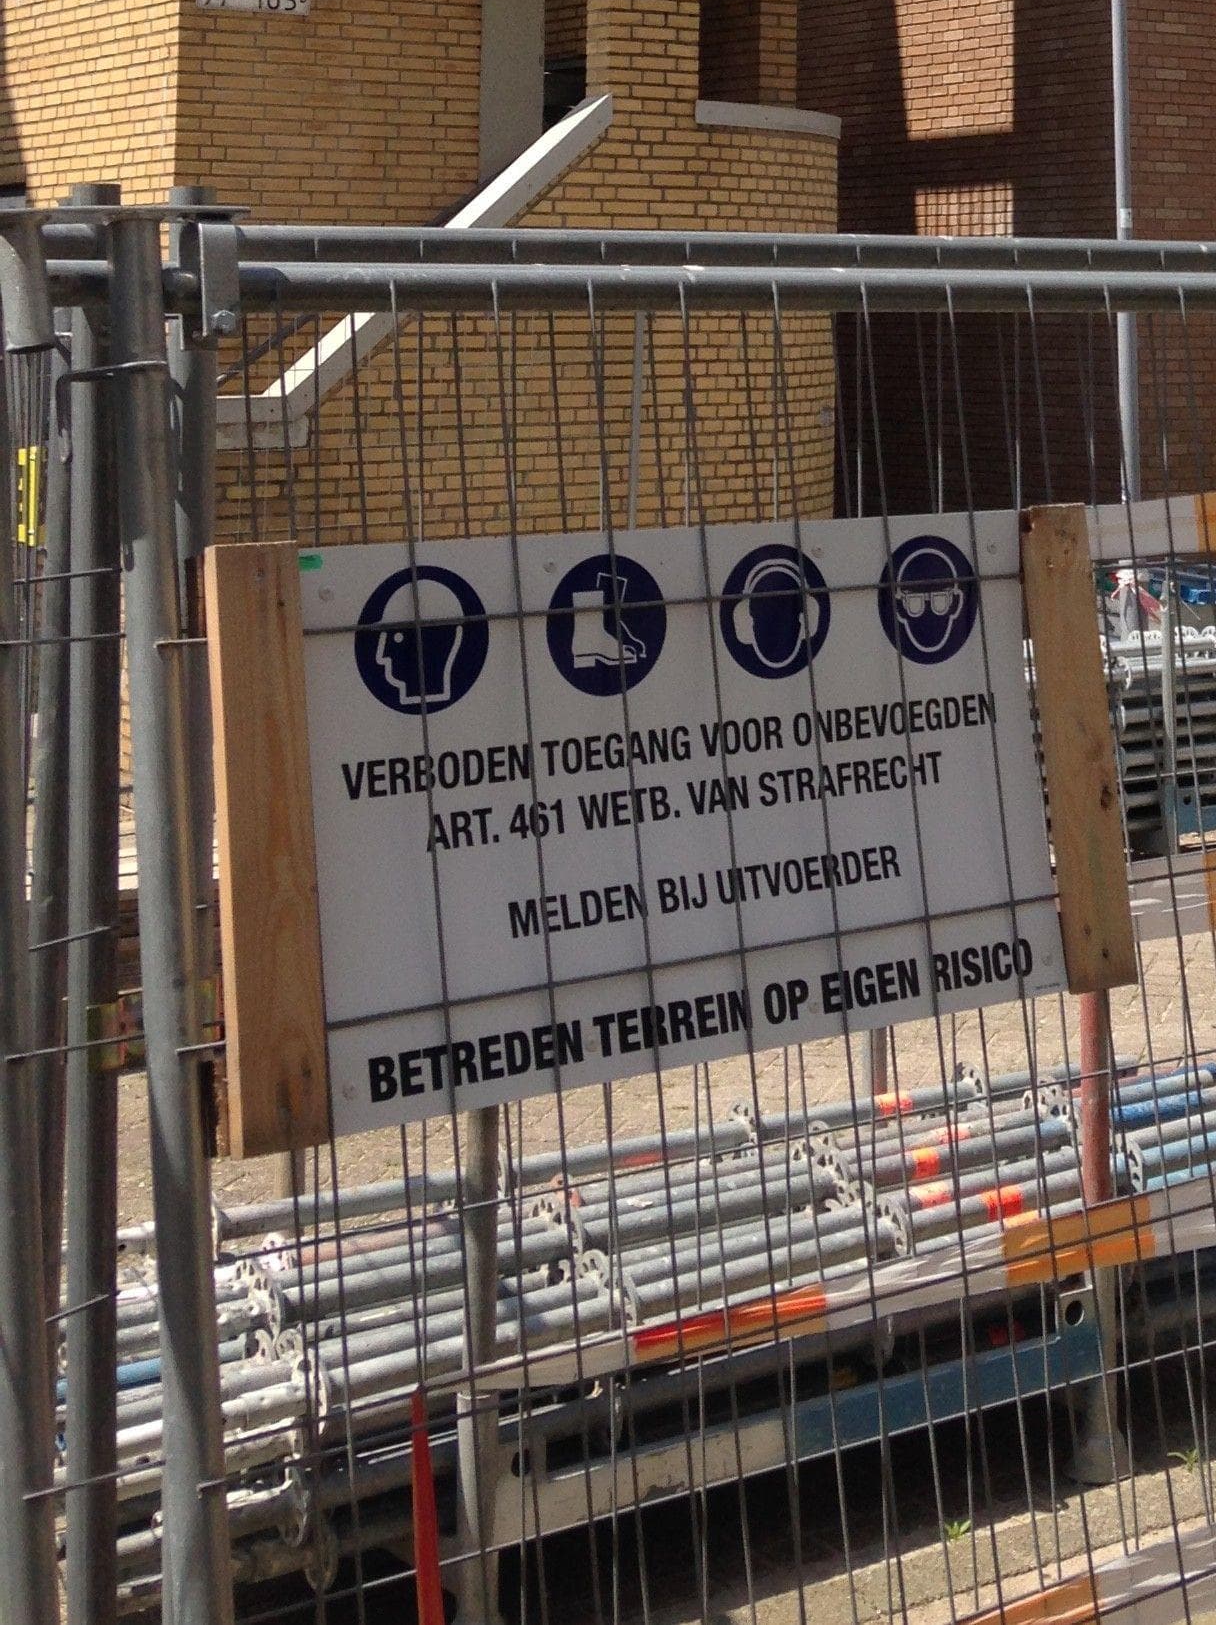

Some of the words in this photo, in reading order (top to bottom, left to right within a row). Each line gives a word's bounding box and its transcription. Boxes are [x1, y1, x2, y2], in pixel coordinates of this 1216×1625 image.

[341, 743, 533, 800] VERBODEN
[541, 726, 691, 776] TOEGANG
[700, 716, 783, 757] VOOR
[793, 693, 996, 747] ONBEVOEGDEN
[427, 807, 500, 852] ART.
[509, 799, 565, 840] 461
[578, 785, 681, 831] WETB.
[687, 775, 749, 815] VAN
[759, 751, 942, 807] STRAFRECHT
[508, 883, 647, 938] MELDEN
[658, 873, 708, 914] BIJ
[716, 845, 901, 905] UITVOERDER
[368, 1020, 584, 1103] BETREDEN
[592, 989, 752, 1057] TERREIN
[763, 979, 809, 1025] OP
[820, 958, 921, 1015] EIGEN
[931, 938, 1033, 993] RISICO
